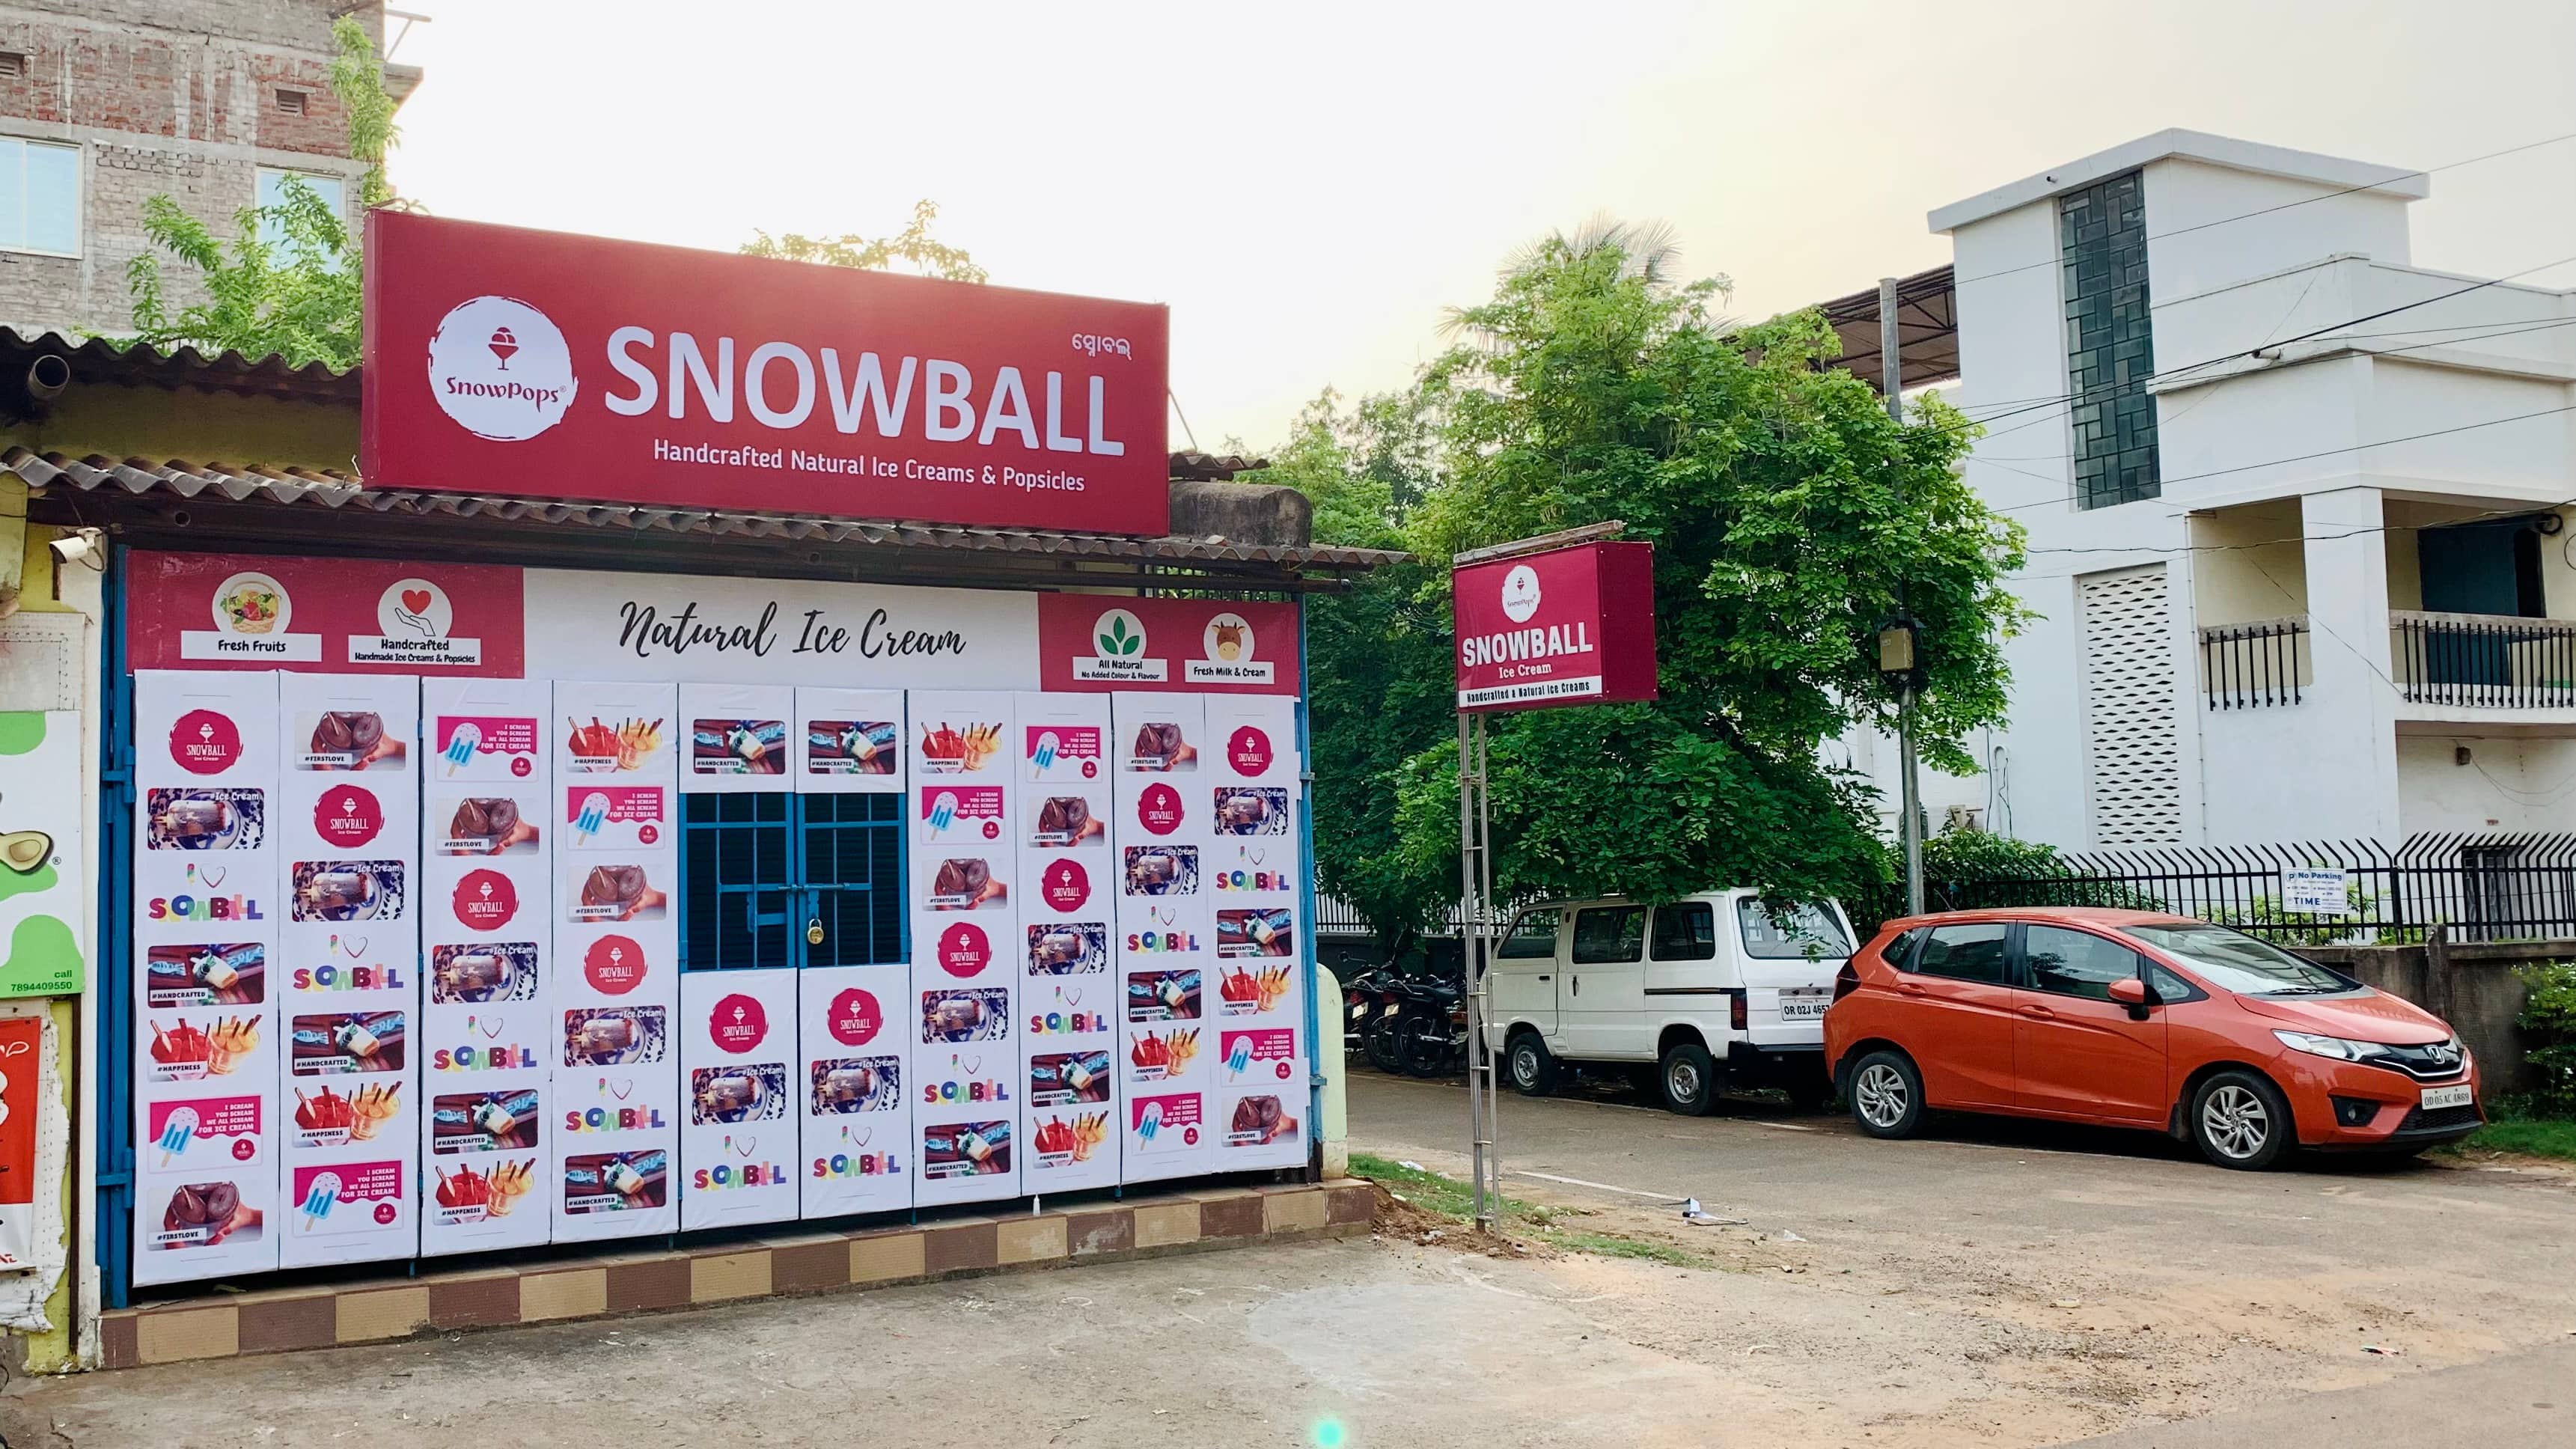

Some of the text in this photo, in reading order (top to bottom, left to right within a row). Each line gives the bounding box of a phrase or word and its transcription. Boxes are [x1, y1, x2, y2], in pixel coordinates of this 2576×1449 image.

[605, 325, 1125, 457] SNOWBALL
[653, 437, 1086, 493] Handcrafted Natural Ice Creams & Popsicles
[619, 600, 967, 659] Natural Ice Cream
[218, 639, 287, 653] Fresh Fruits
[381, 638, 449, 651] Handcrafted
[1462, 622, 1593, 668] SNOWBALL
[355, 652, 475, 664] Handmade Ice Creams & Popsicles
[1099, 659, 1143, 670] All Natural
[1194, 666, 1266, 677] Fresh Milk & Cream
[1499, 662, 1552, 679] Ice Cream
[1138, 672, 1160, 680] Flavour
[1519, 684, 1545, 697] Natural
[1547, 684, 1559, 695] Ice
[1561, 681, 1590, 692] Creams
[186, 745, 227, 756] SNOWBALL
[1238, 753, 1263, 763] SNOWBALL
[231, 792, 259, 802] Cream
[1149, 811, 1174, 820] SNOWBALL
[330, 818, 368, 830] SNOWBALL
[374, 864, 400, 873] Cream
[2311, 873, 2342, 882] Parking
[1053, 887, 1081, 897] SNOWBALL
[2294, 897, 2321, 906] TIME
[468, 902, 504, 913] SNOWBALL
[508, 946, 533, 955] Cream
[950, 952, 980, 962] SNOWBALL
[55, 970, 73, 978] call
[599, 967, 634, 977] SNOWBALL
[11, 982, 73, 992] 7894409550
[152, 991, 206, 999] #HANDCRAFTED
[983, 991, 1004, 999] Cream
[637, 1009, 662, 1018] Cream
[1784, 1005, 1795, 1015] OR
[1797, 1005, 1811, 1015] 02J
[840, 1019, 871, 1030] SNOWBALL
[723, 1025, 756, 1037] SNOWBALL
[157, 1064, 201, 1072] #HAPPINESS
[296, 1059, 348, 1067] #HANDCRAFTED
[875, 1059, 897, 1067] Cream
[760, 1067, 782, 1076] Cream
[198, 1123, 254, 1134] FOR ICE CREAM
[302, 1130, 344, 1138] #HAPPINESS
[437, 1138, 486, 1146] #HANDCRAFTED
[370, 1188, 395, 1196] CREAM
[569, 1198, 615, 1206] #HANDCRAFTED
[442, 1207, 480, 1215] #HAPPINESS
[157, 1231, 199, 1240] #FIRSTLOVE
